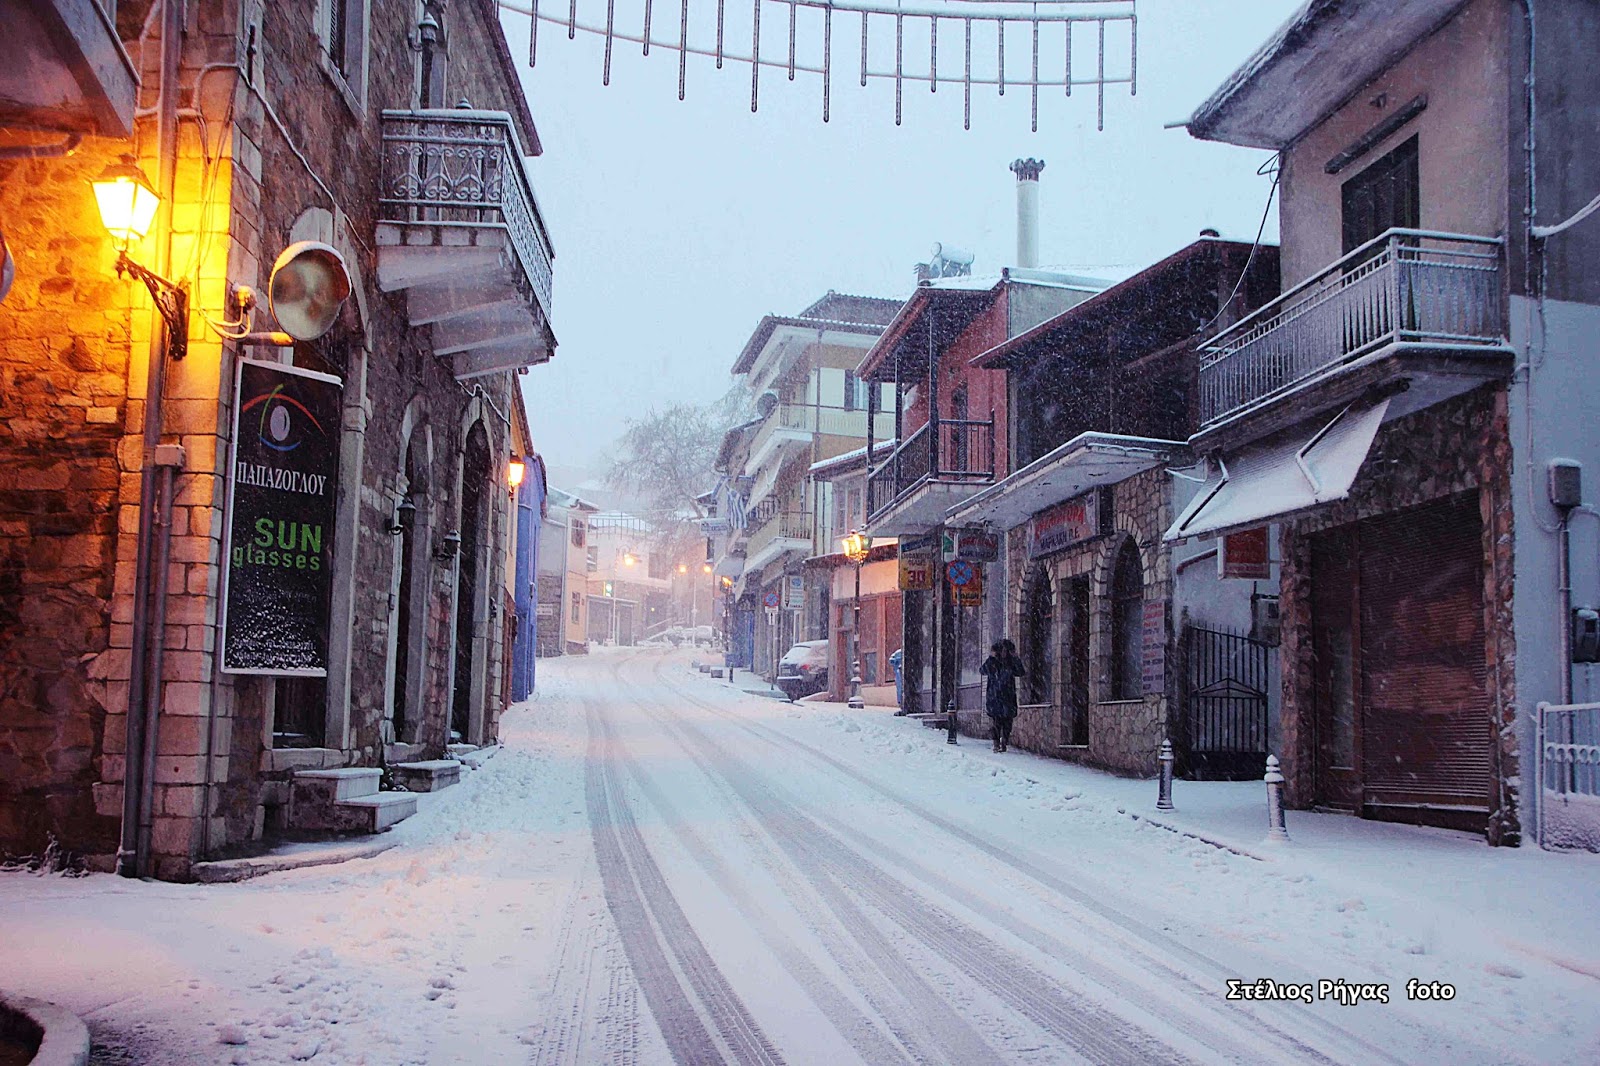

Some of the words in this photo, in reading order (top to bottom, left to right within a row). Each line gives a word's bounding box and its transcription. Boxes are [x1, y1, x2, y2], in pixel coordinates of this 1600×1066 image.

[236, 461, 327, 496] ΠΑΠΑΖΟΓΛΟΥ
[254, 518, 322, 554] SUN
[233, 543, 320, 571] glasses
